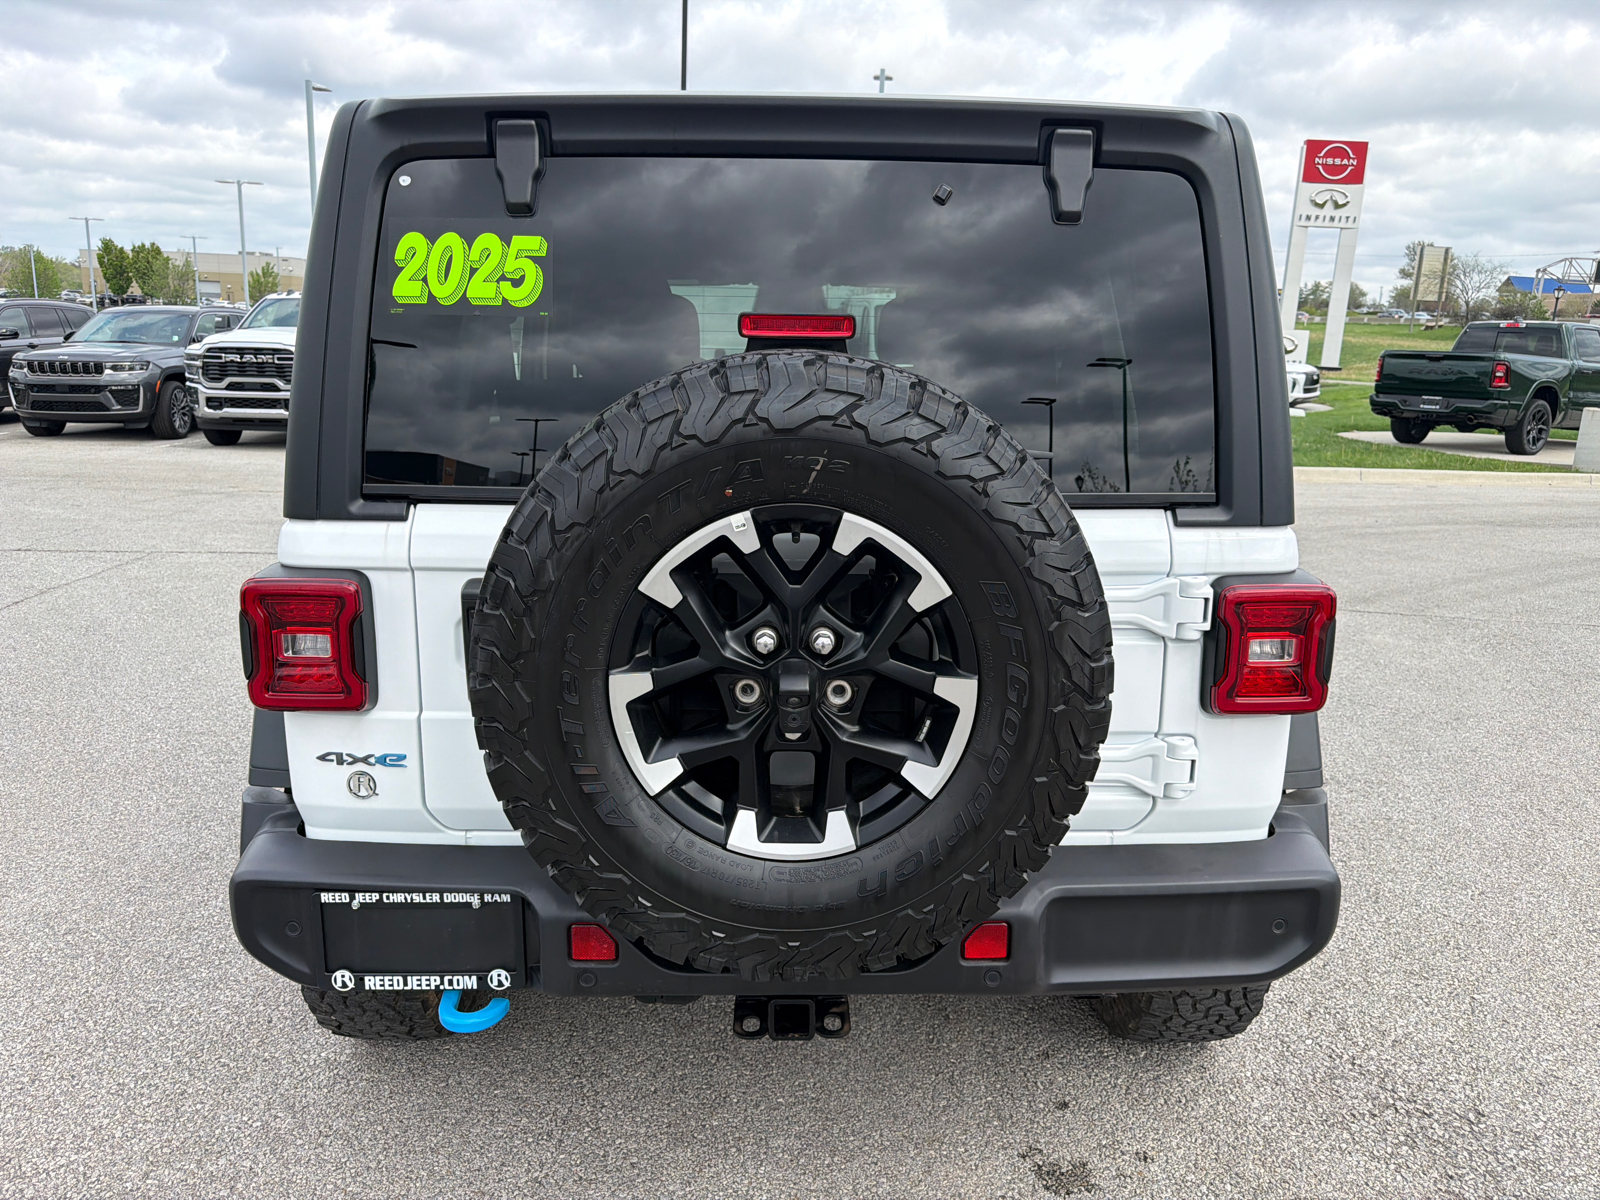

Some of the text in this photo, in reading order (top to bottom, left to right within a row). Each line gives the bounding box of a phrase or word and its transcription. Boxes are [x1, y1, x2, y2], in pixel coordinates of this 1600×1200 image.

[1314, 157, 1357, 166] NISSAN
[1298, 213, 1357, 225] INFINITI
[392, 231, 548, 308] 2025
[225, 354, 274, 363] RAM
[657, 457, 765, 516] T/A
[856, 580, 1030, 899] BFGoodrich
[697, 847, 728, 865] RANGE
[729, 859, 754, 873] LOAD
[320, 892, 511, 903] REED JEEP CHRYSLER DODGE RAM
[364, 975, 478, 990] REEDJEEP.COM
